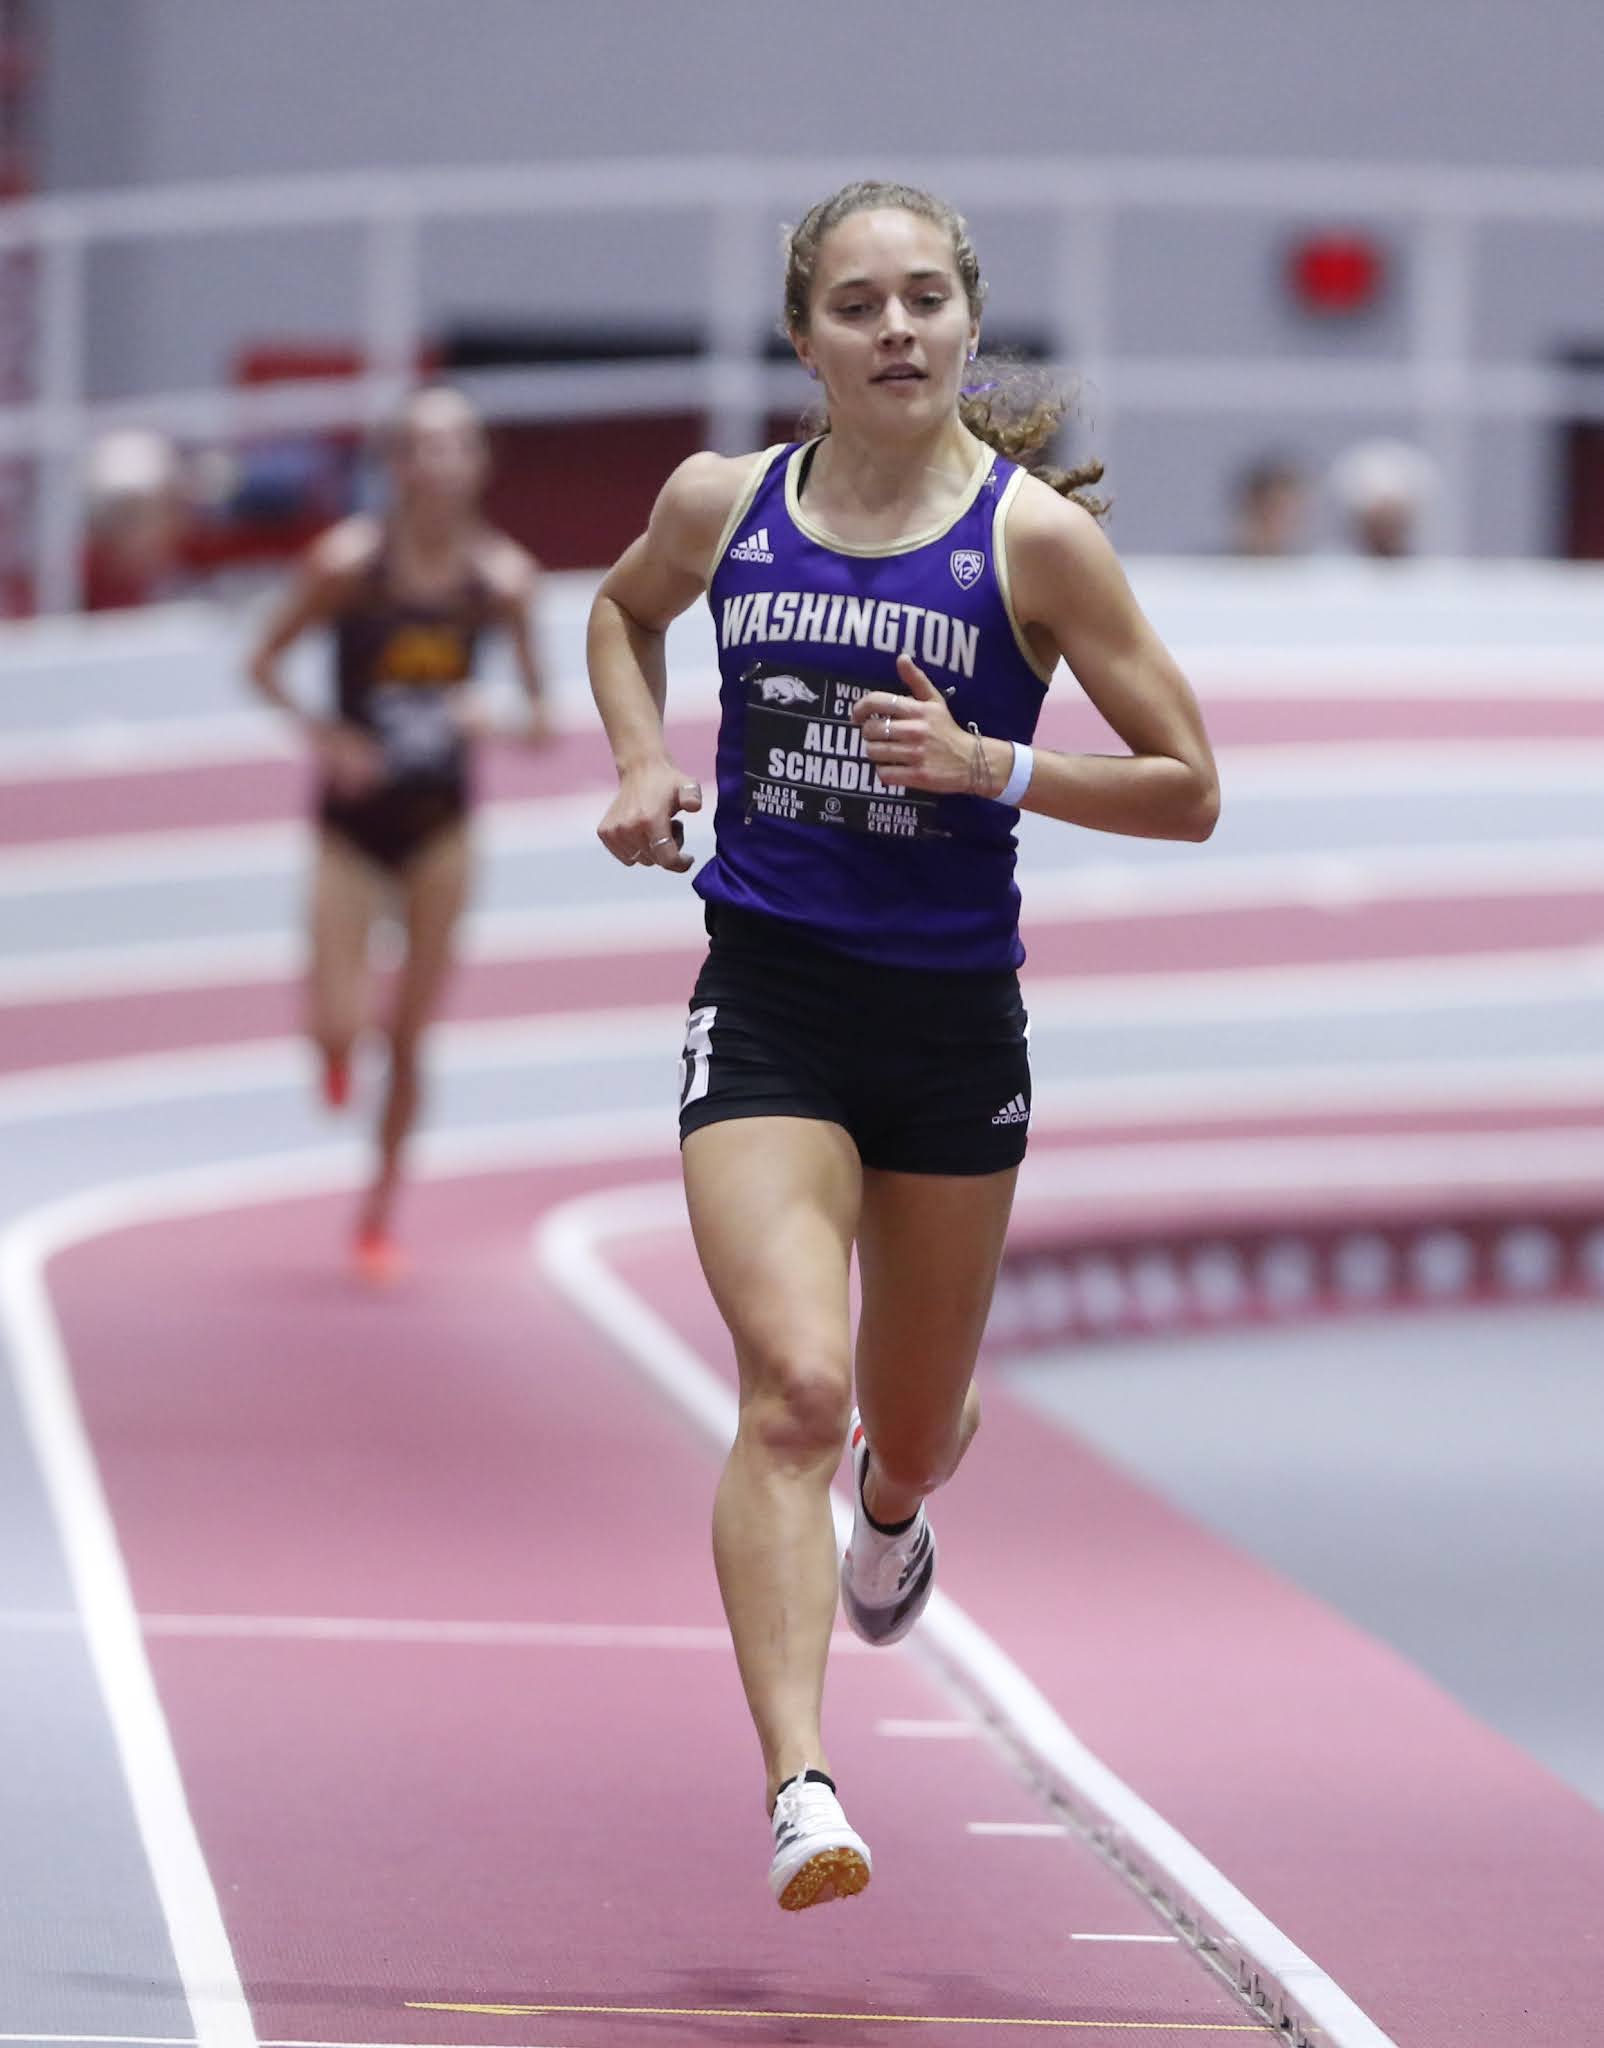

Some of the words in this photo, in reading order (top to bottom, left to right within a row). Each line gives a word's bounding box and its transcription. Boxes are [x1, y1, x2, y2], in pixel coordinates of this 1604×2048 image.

[730, 548, 774, 564] adidas
[958, 565, 975, 581] 12
[722, 591, 980, 679] WASHINGTON
[760, 782, 798, 800] TRACK
[757, 800, 797, 819] WORLD
[991, 1110, 1029, 1125] adidas
